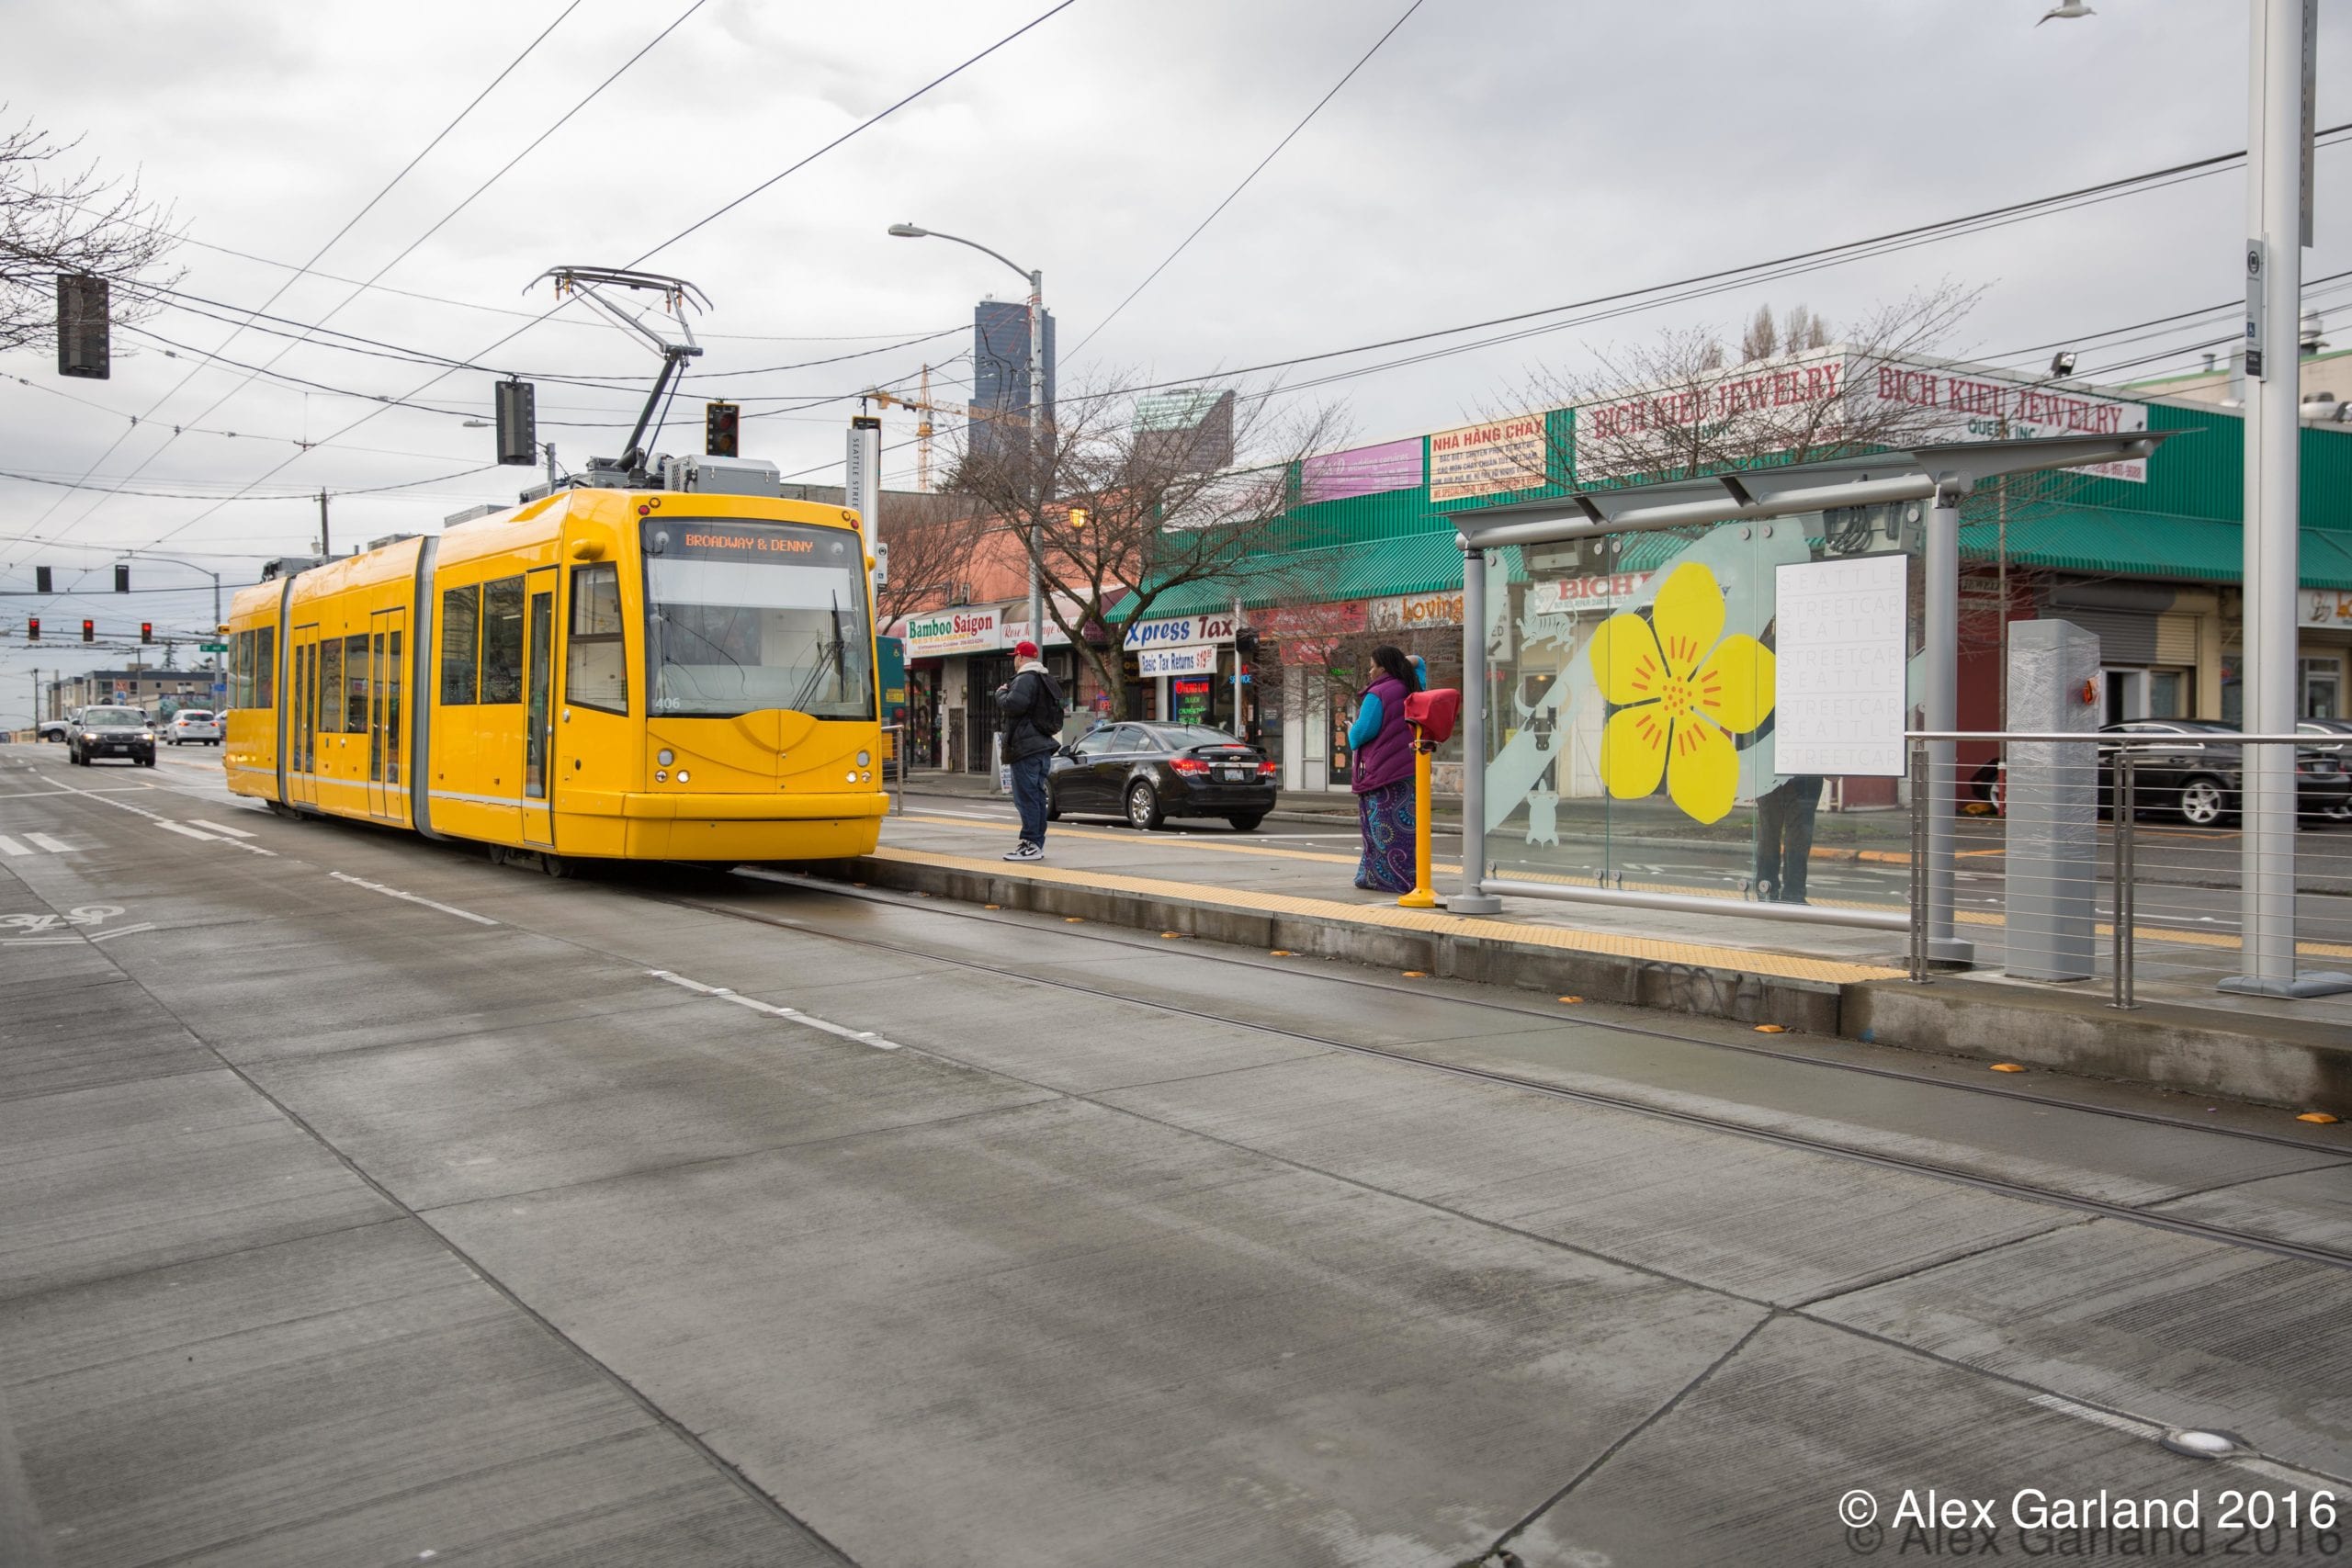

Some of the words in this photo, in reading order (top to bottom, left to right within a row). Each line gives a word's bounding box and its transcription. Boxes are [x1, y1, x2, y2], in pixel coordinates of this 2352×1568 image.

[1594, 401, 1646, 439] BICH
[1715, 363, 1840, 417] JEWELRY
[1878, 367, 1939, 407] BICH
[1949, 378, 2007, 417] KIEU
[2018, 389, 2122, 434] JEWELRY
[1506, 420, 1543, 440] CHAY
[685, 534, 754, 549] BROADWAY
[757, 538, 767, 550] &
[771, 539, 813, 552] DENNY
[1559, 575, 1634, 600] BICH
[1781, 566, 1899, 591] SEATTLE
[1402, 595, 1464, 624] Loving
[1781, 595, 1899, 618] STREETCAR
[909, 618, 952, 638] Bamboo
[954, 614, 992, 636] Saigon
[1125, 620, 1190, 647] Xpress
[1199, 615, 1233, 638] Tax
[1780, 617, 1899, 639] SEATTLE
[911, 632, 971, 645] RESTAURANT
[1142, 654, 1156, 671] Basic
[1159, 653, 1169, 671] Tax
[1171, 652, 1193, 670] Returns
[1780, 647, 1899, 667] STREETCAR
[1780, 669, 1899, 688] SEATTLE
[655, 697, 680, 708] 406
[1780, 698, 1898, 716] STREETCAR
[1780, 720, 1898, 737] SEATTLE
[1780, 749, 1898, 766] STREETCAR
